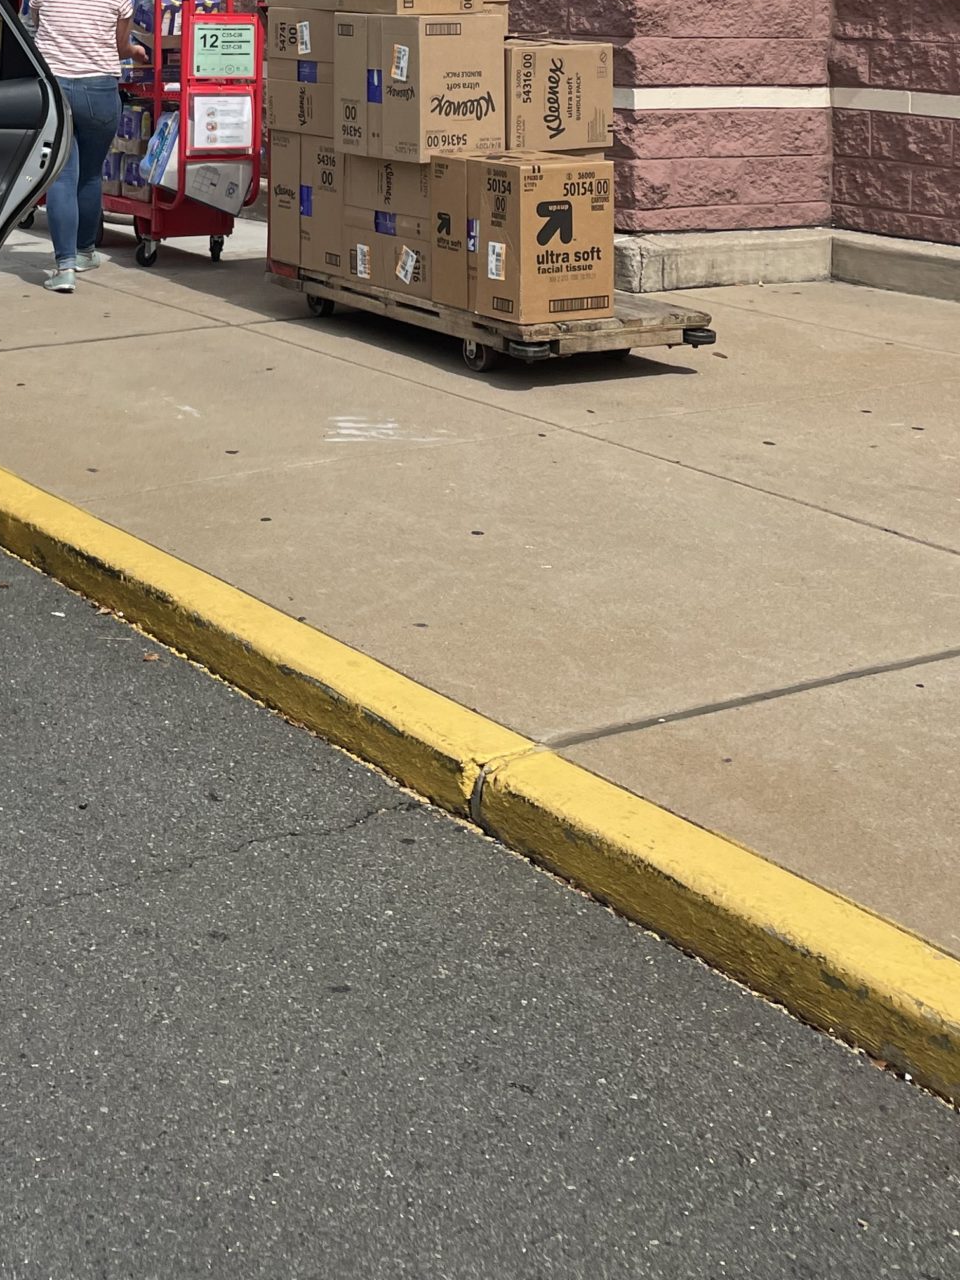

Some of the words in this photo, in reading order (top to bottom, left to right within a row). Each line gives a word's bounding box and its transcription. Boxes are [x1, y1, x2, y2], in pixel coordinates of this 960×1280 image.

[200, 33, 218, 48] 12
[288, 27, 297, 45] 00
[522, 53, 532, 69] 00
[386, 86, 415, 102] Kleenex
[446, 83, 461, 91] soft
[462, 82, 480, 91] ultra
[522, 71, 532, 104] 54316
[297, 87, 307, 126] Kleenex
[430, 91, 496, 121] Kleenex
[543, 58, 566, 140] Kleenex
[344, 105, 357, 121] 00
[342, 124, 362, 138] 54316
[427, 135, 439, 148] 00
[441, 133, 467, 146] 54316
[317, 153, 336, 167] 54316
[321, 170, 333, 185] 00
[383, 163, 394, 205] Kleenex
[274, 184, 296, 200] Kleenex
[487, 178, 512, 195] 50154
[563, 181, 594, 197] 50154
[597, 180, 608, 194] 00
[495, 196, 506, 212] 00
[536, 249, 570, 265] ultra
[574, 246, 602, 262] soft
[537, 264, 563, 275] facial
[565, 263, 593, 272] tissue
